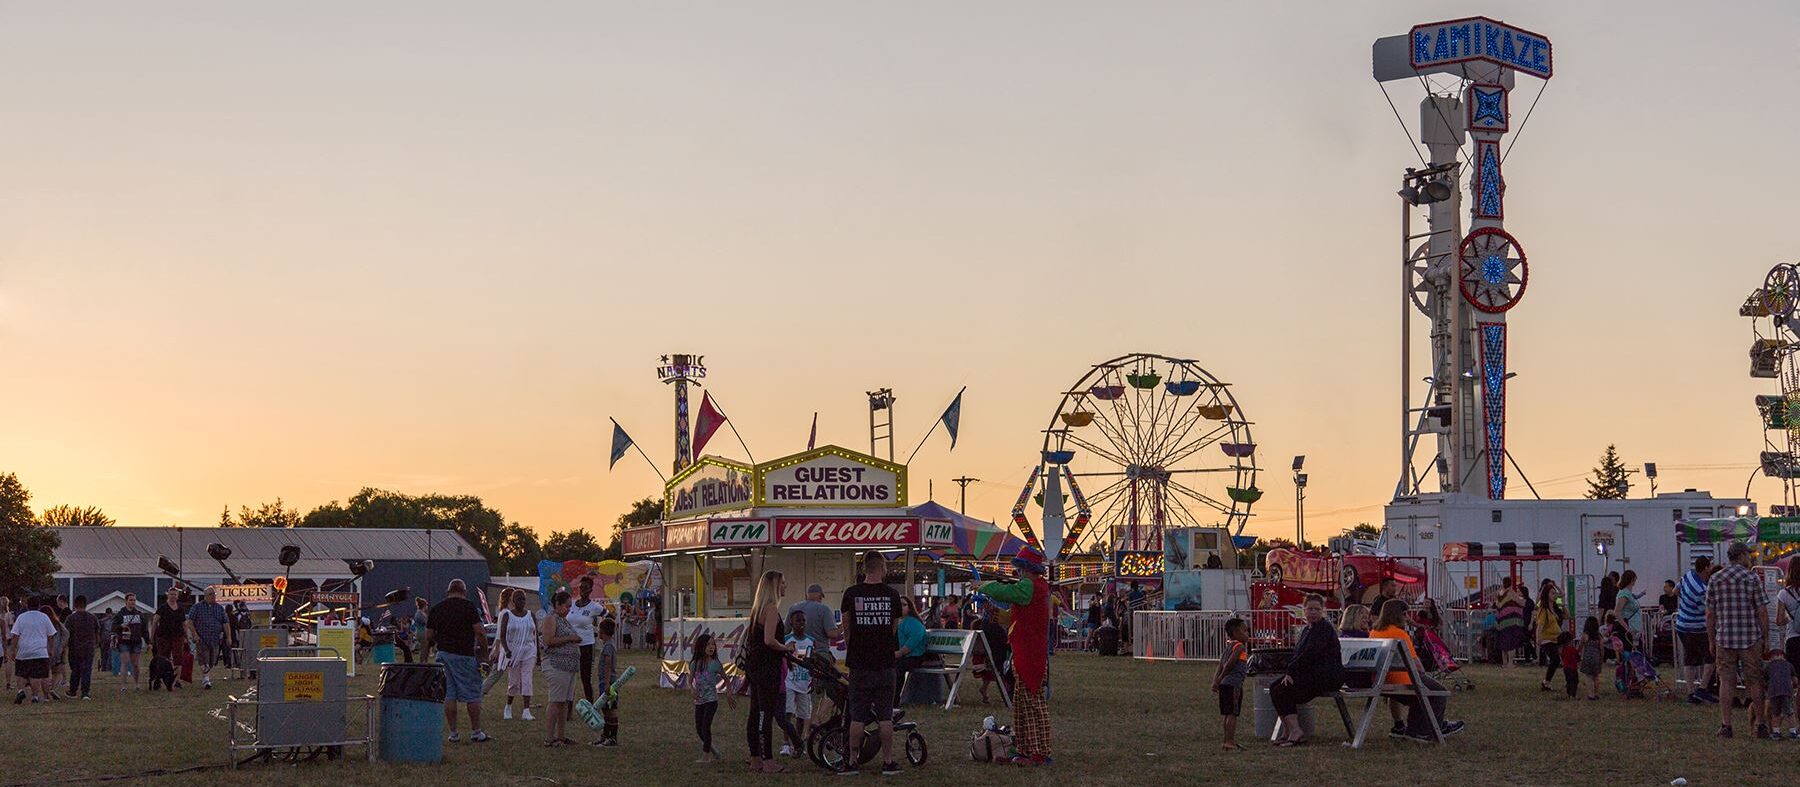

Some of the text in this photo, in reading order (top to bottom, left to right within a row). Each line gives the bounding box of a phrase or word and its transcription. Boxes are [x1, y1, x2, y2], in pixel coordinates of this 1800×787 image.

[1414, 22, 1549, 73] KAMIKAZE
[794, 467, 866, 483] GUEST
[702, 475, 750, 507] RELATIONS
[773, 484, 889, 501] RELATIONS
[713, 523, 766, 541] ATM
[781, 521, 913, 542] WELCOME
[926, 524, 952, 540] ATM
[220, 587, 268, 598] TICKETS
[864, 602, 892, 611] FREE
[856, 617, 891, 625] BRAVE
[1359, 647, 1377, 661] FAIR
